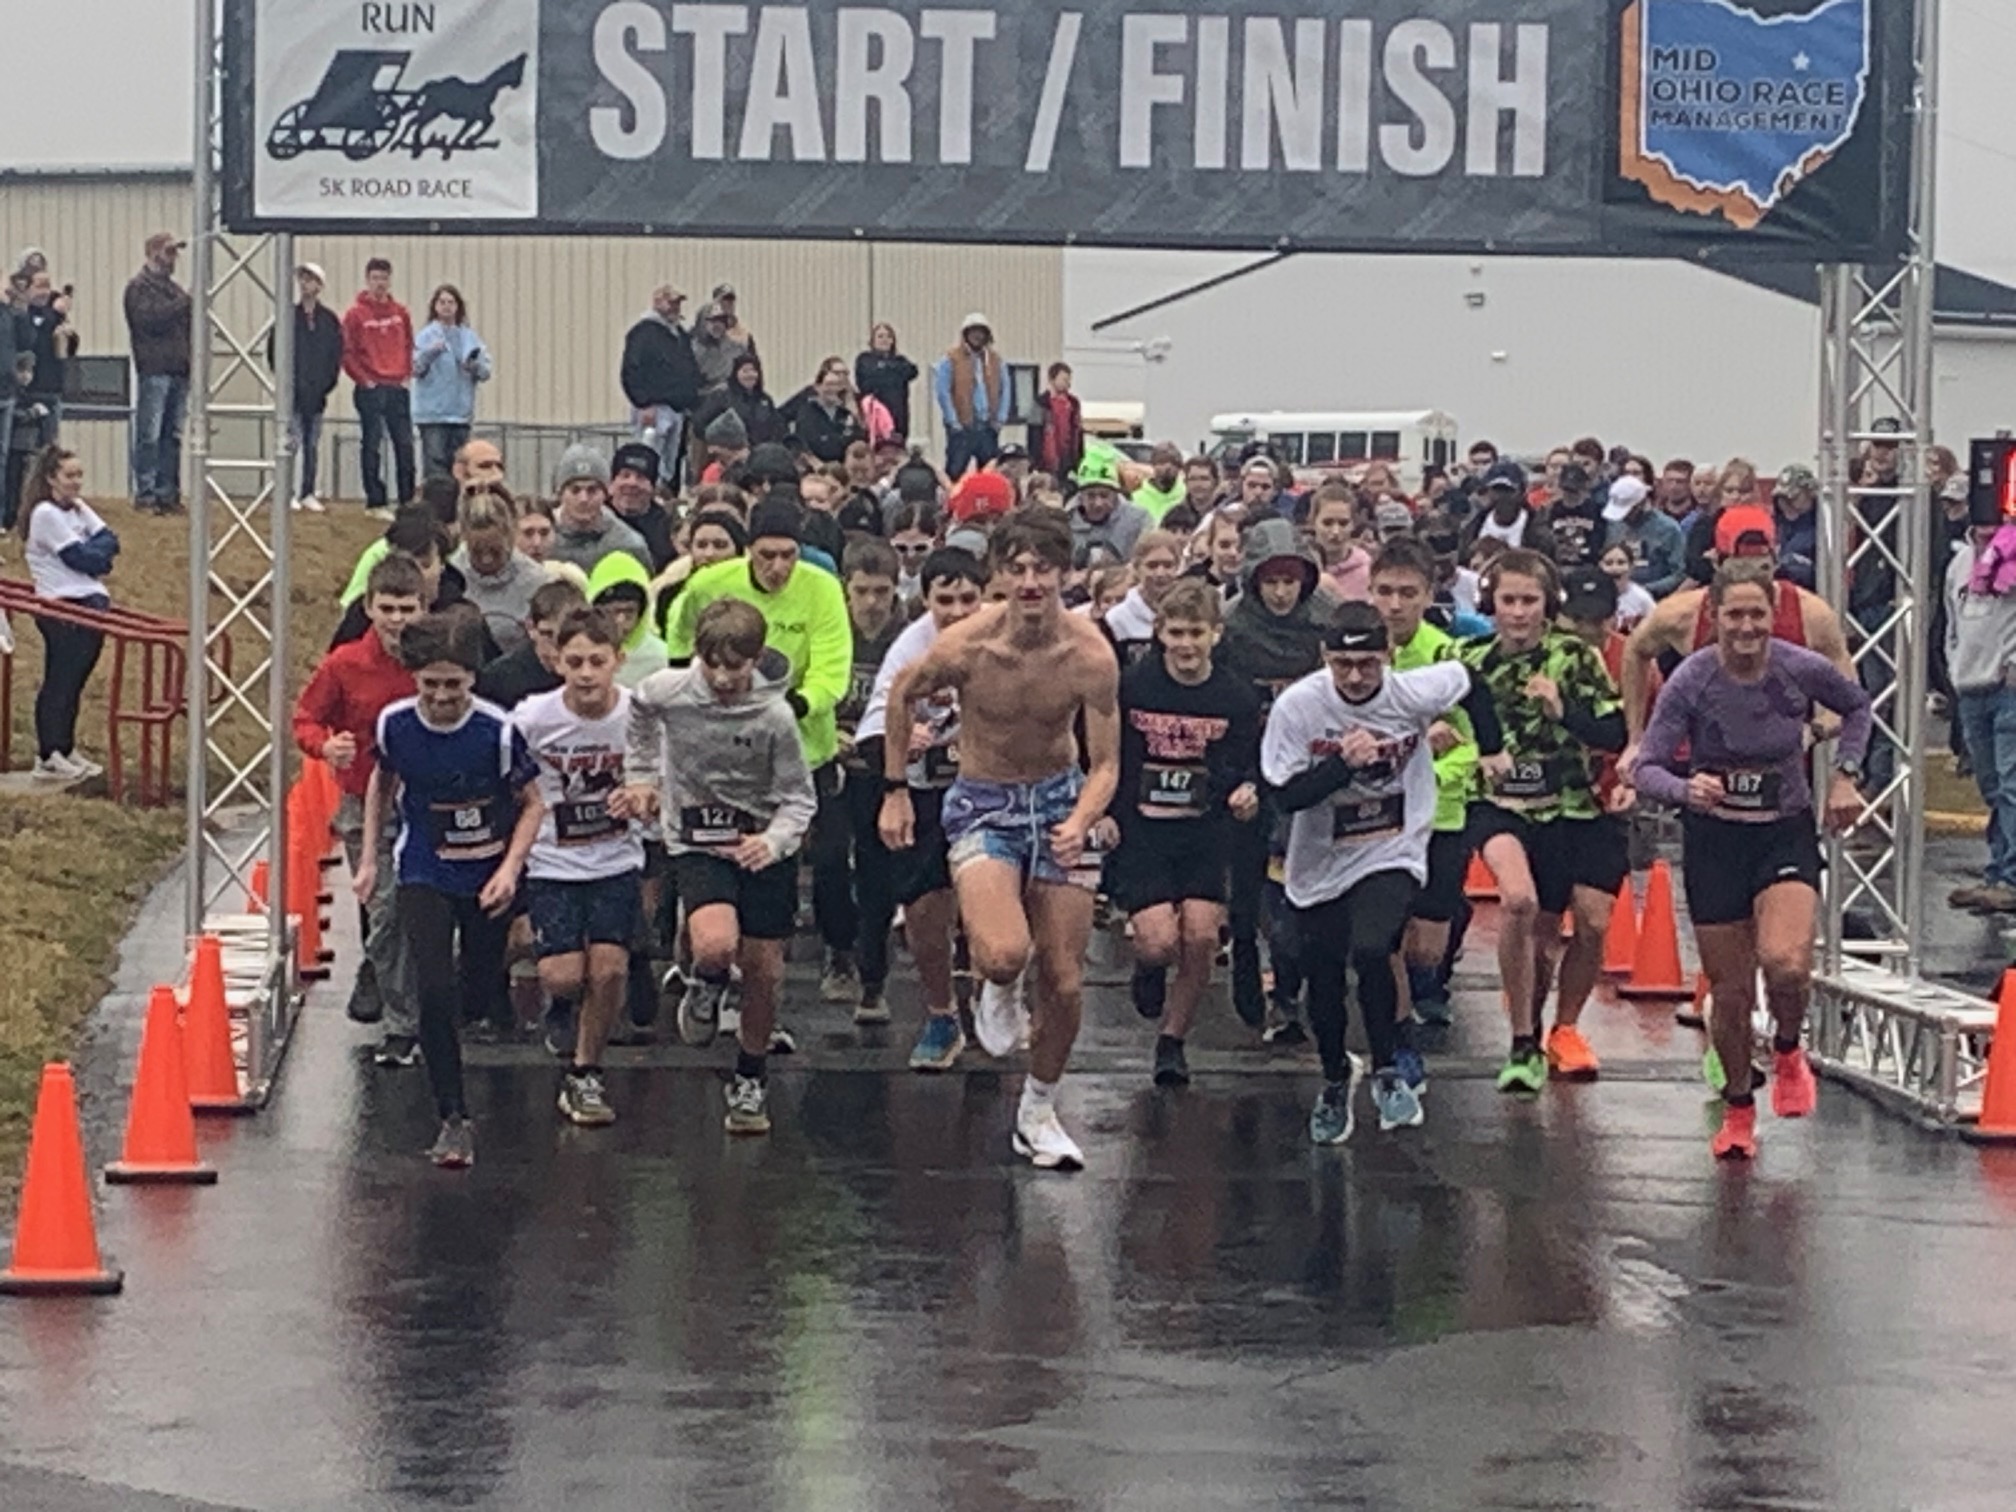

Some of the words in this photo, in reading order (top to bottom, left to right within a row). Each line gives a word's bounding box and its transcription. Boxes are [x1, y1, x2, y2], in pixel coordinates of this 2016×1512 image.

[361, 2, 435, 33] RUN
[1651, 47, 1717, 72] MID
[589, 1, 997, 163] START
[1024, 12, 1084, 173] /
[1119, 13, 1550, 177] FINISH
[1651, 78, 1742, 102] OHIO
[1752, 80, 1846, 106] RACE
[1650, 109, 1847, 132] MANAGEMENT
[319, 177, 345, 198] 5K
[351, 177, 411, 198] ROAD
[417, 179, 473, 199] RACE
[1160, 769, 1192, 790] 147
[701, 807, 736, 827] 127
